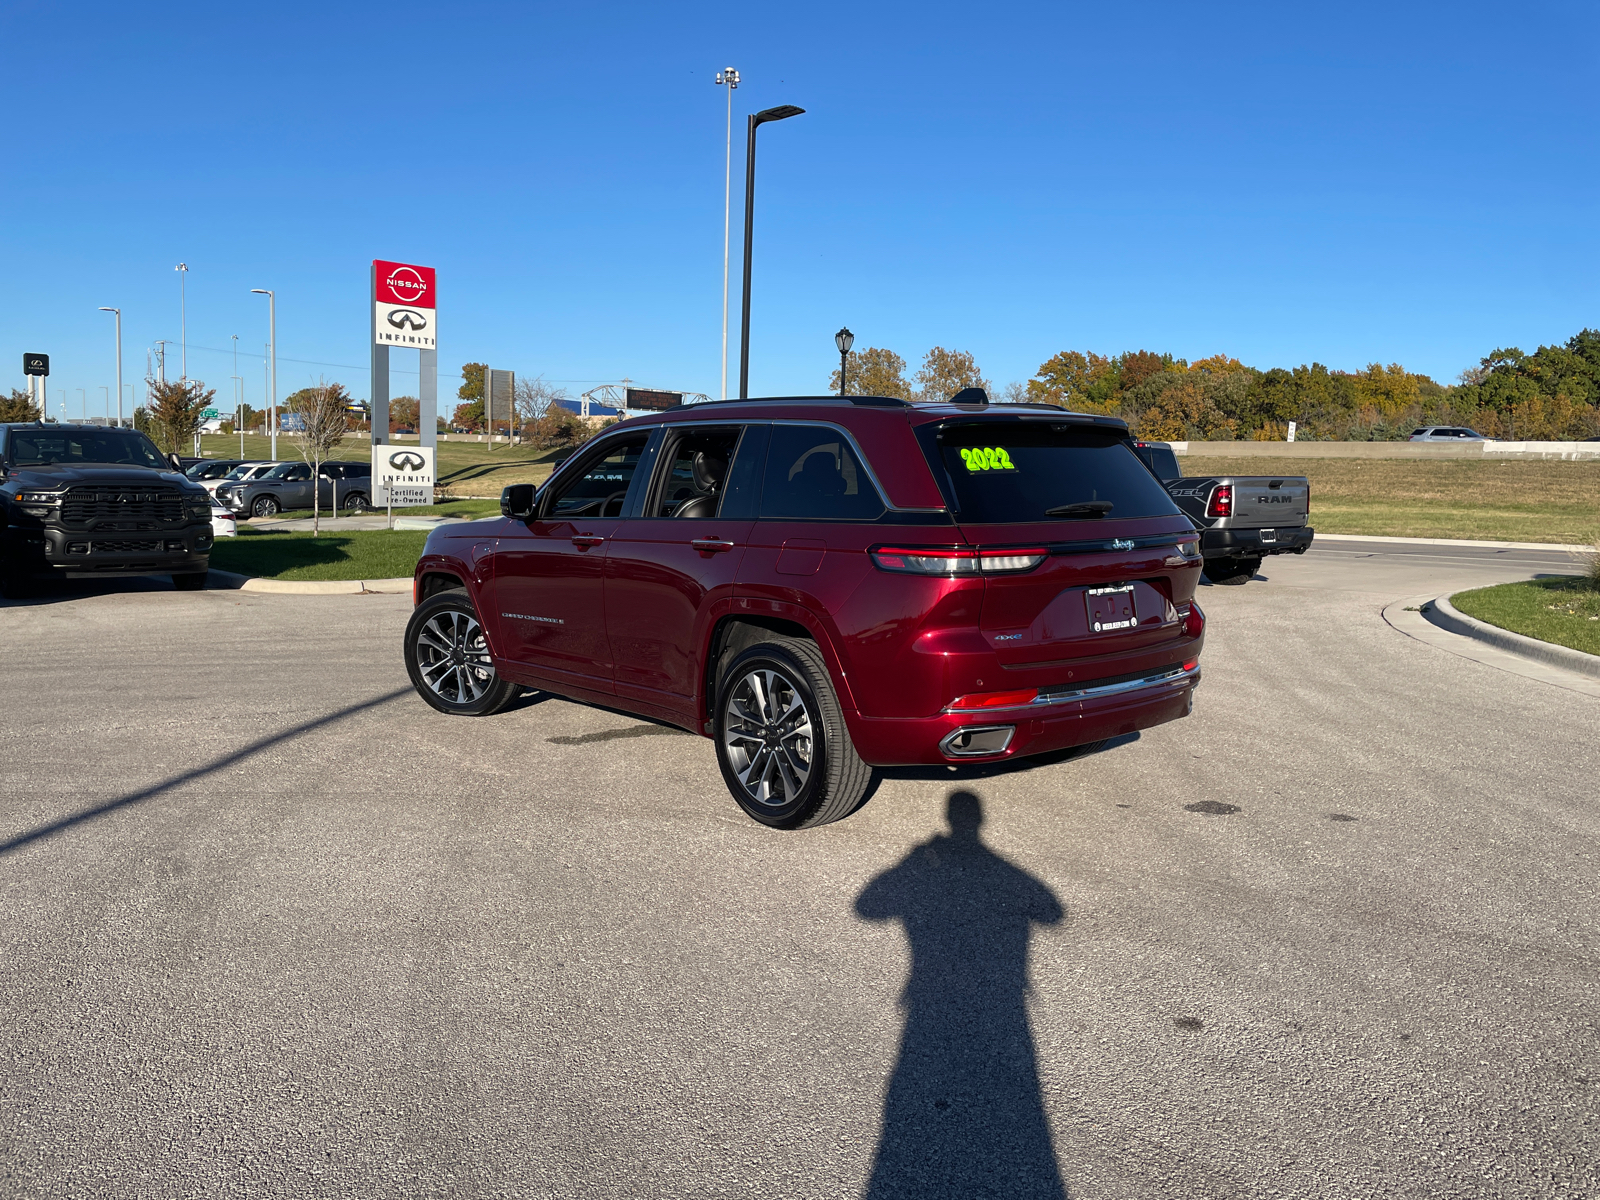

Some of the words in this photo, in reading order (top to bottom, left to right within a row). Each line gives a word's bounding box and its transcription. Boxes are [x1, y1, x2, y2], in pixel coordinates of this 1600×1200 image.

[386, 278, 427, 290] NISSAN
[379, 332, 435, 346] INFINITI
[960, 446, 1015, 471] 2022
[382, 475, 431, 483] INFINITI
[95, 493, 159, 503] RAM
[390, 488, 424, 497] Certified
[1257, 495, 1293, 504] RAM
[1112, 538, 1135, 552] Jeep
